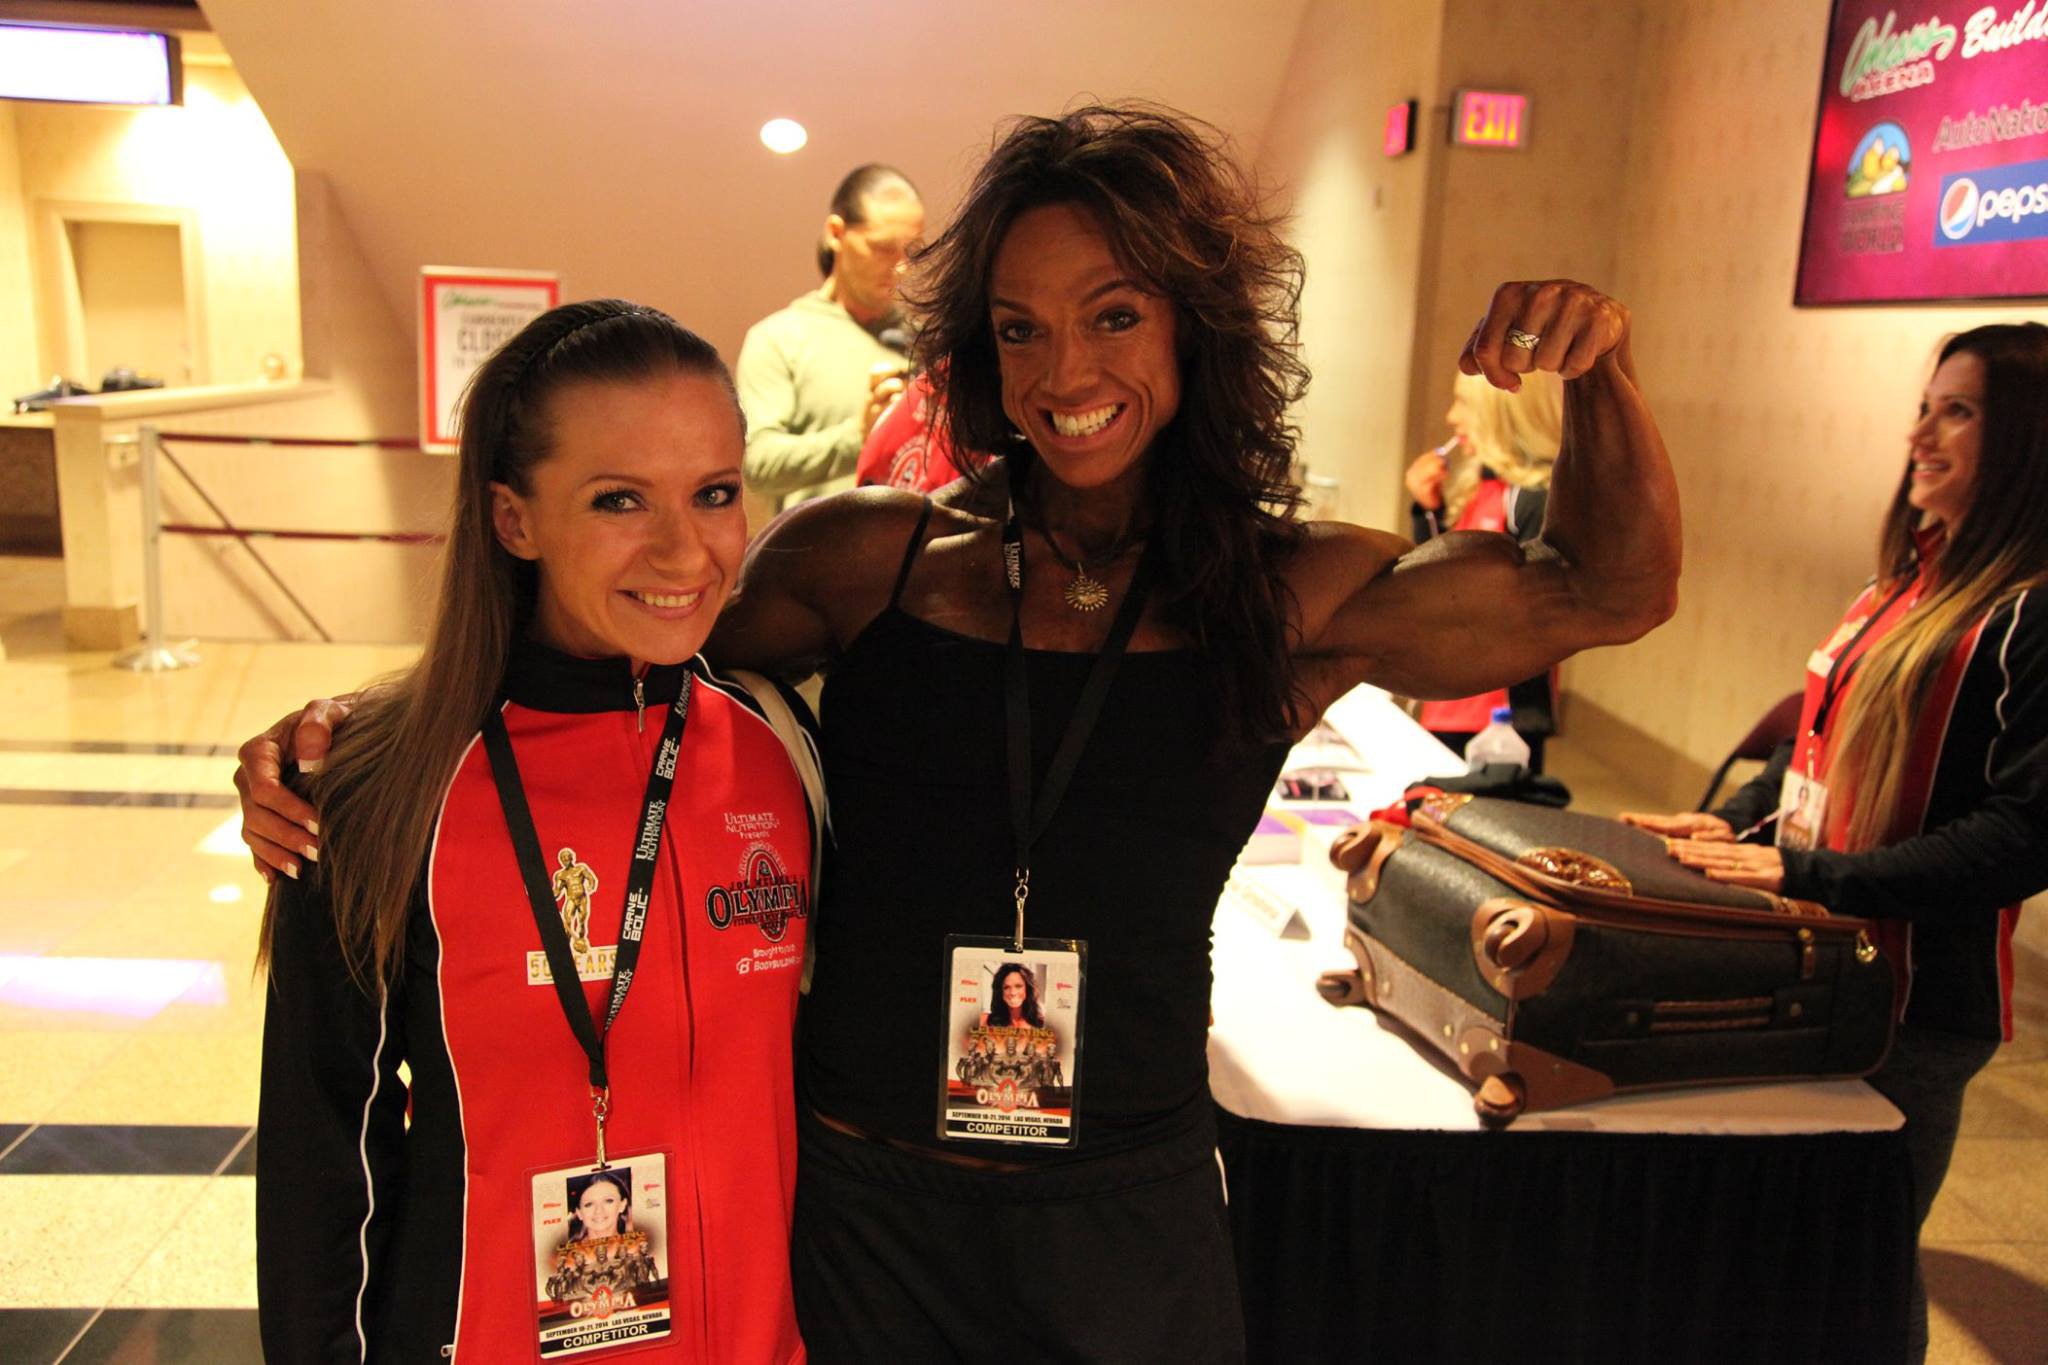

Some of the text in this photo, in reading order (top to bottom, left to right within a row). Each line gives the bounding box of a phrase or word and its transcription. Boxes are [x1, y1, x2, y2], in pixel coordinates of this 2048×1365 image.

[1961, 0, 2048, 59] Build
[635, 801, 660, 860] ULTIMATE
[723, 812, 775, 825] ULTIMATE
[622, 892, 638, 940] CARNE
[573, 951, 617, 975] EARS
[952, 1111, 981, 1120] SEPTEMBER
[966, 1122, 1048, 1137] COMPETITOR
[545, 1326, 578, 1339] SEPTEMBER
[563, 1324, 649, 1349] COMPETITOR
